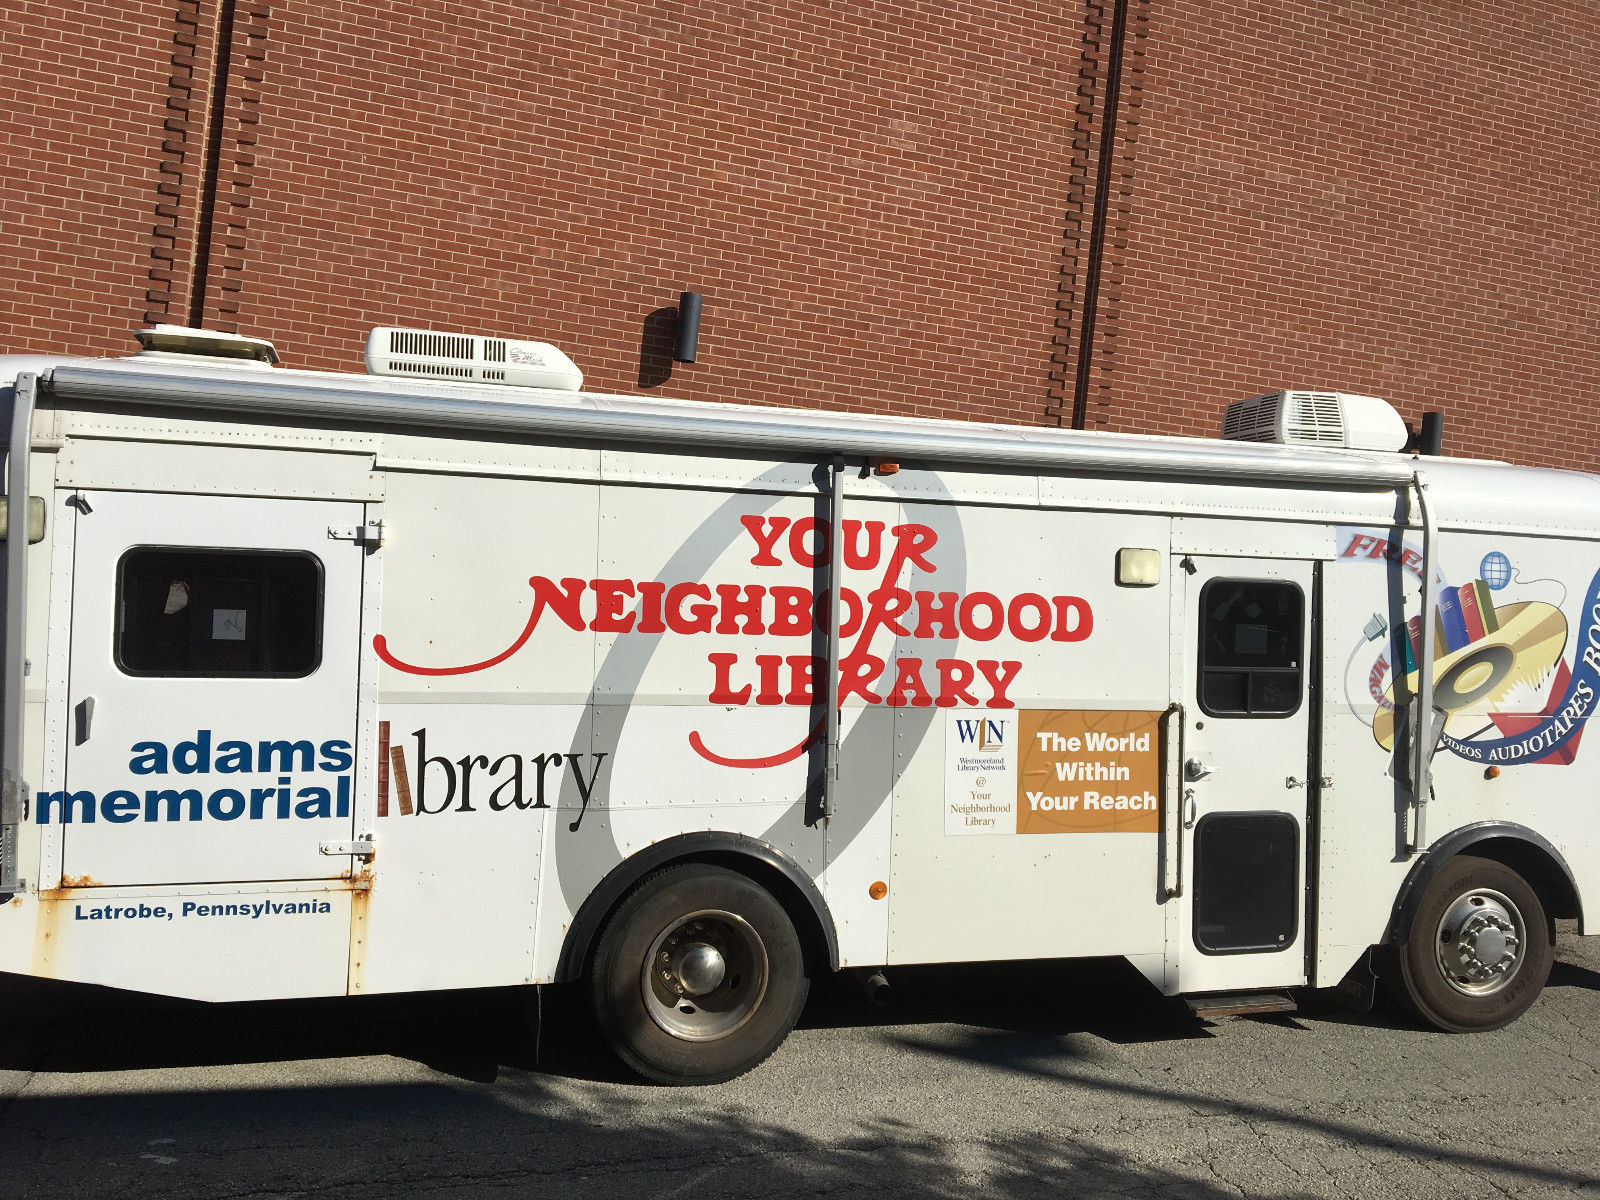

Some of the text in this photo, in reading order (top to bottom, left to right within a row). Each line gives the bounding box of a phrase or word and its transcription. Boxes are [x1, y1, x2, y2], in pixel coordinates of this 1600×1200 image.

[741, 514, 938, 574] YOUR
[1340, 533, 1441, 583] FRE
[515, 576, 1094, 645] NEIGHBORHOOD
[707, 652, 1022, 709] LIBRARY
[1442, 678, 1594, 761] VIDEOS AUDIOTAPES
[128, 729, 353, 775] adams
[1036, 732, 1150, 752] The World
[957, 764, 980, 773] Library
[1055, 761, 1130, 782] Within
[36, 775, 351, 824] memorial
[970, 791, 992, 801] Your
[1026, 791, 1157, 812] Your Reach
[950, 803, 1011, 816] Neighborhood
[965, 816, 997, 828] Library
[74, 898, 332, 921] Latrobe, Pennsylvania
